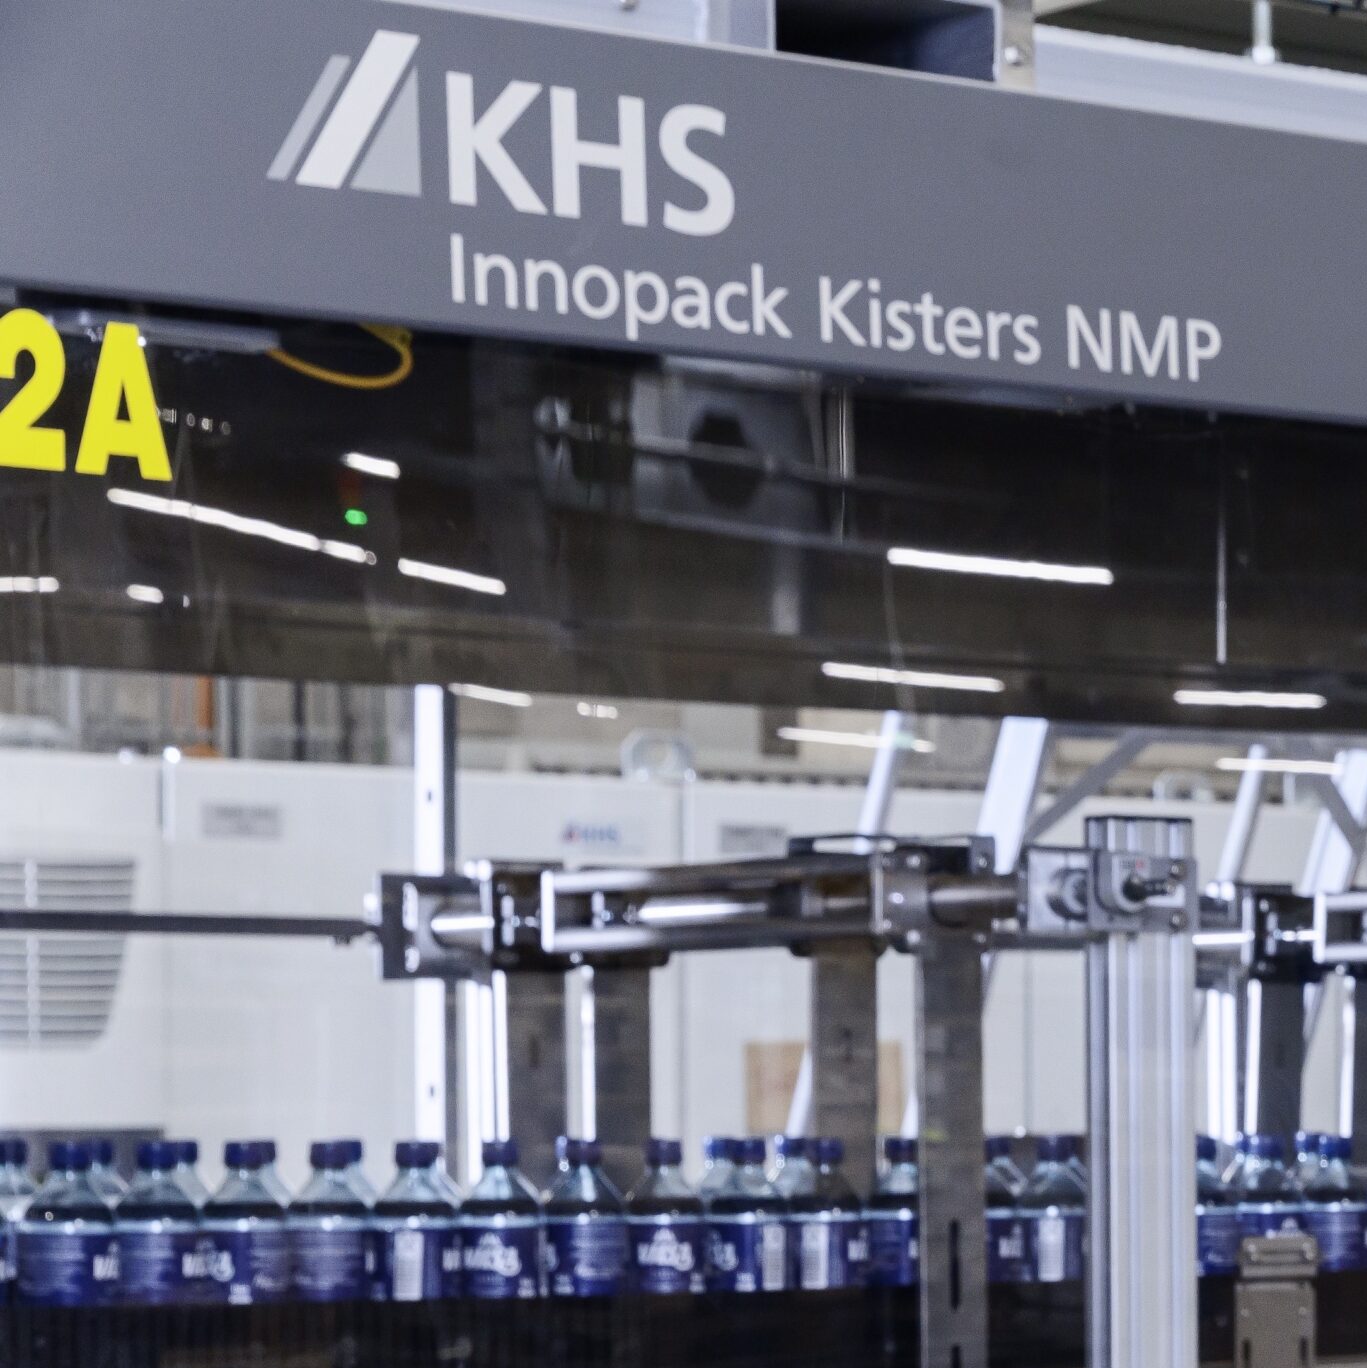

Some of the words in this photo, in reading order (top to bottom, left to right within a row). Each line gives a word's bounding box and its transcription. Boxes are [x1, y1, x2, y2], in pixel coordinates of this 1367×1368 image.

[446, 70, 735, 237] KHS
[450, 233, 792, 341] Innopack
[819, 276, 1041, 365] Kisters
[1066, 304, 1222, 382] NMP
[0, 308, 173, 482] 2A
